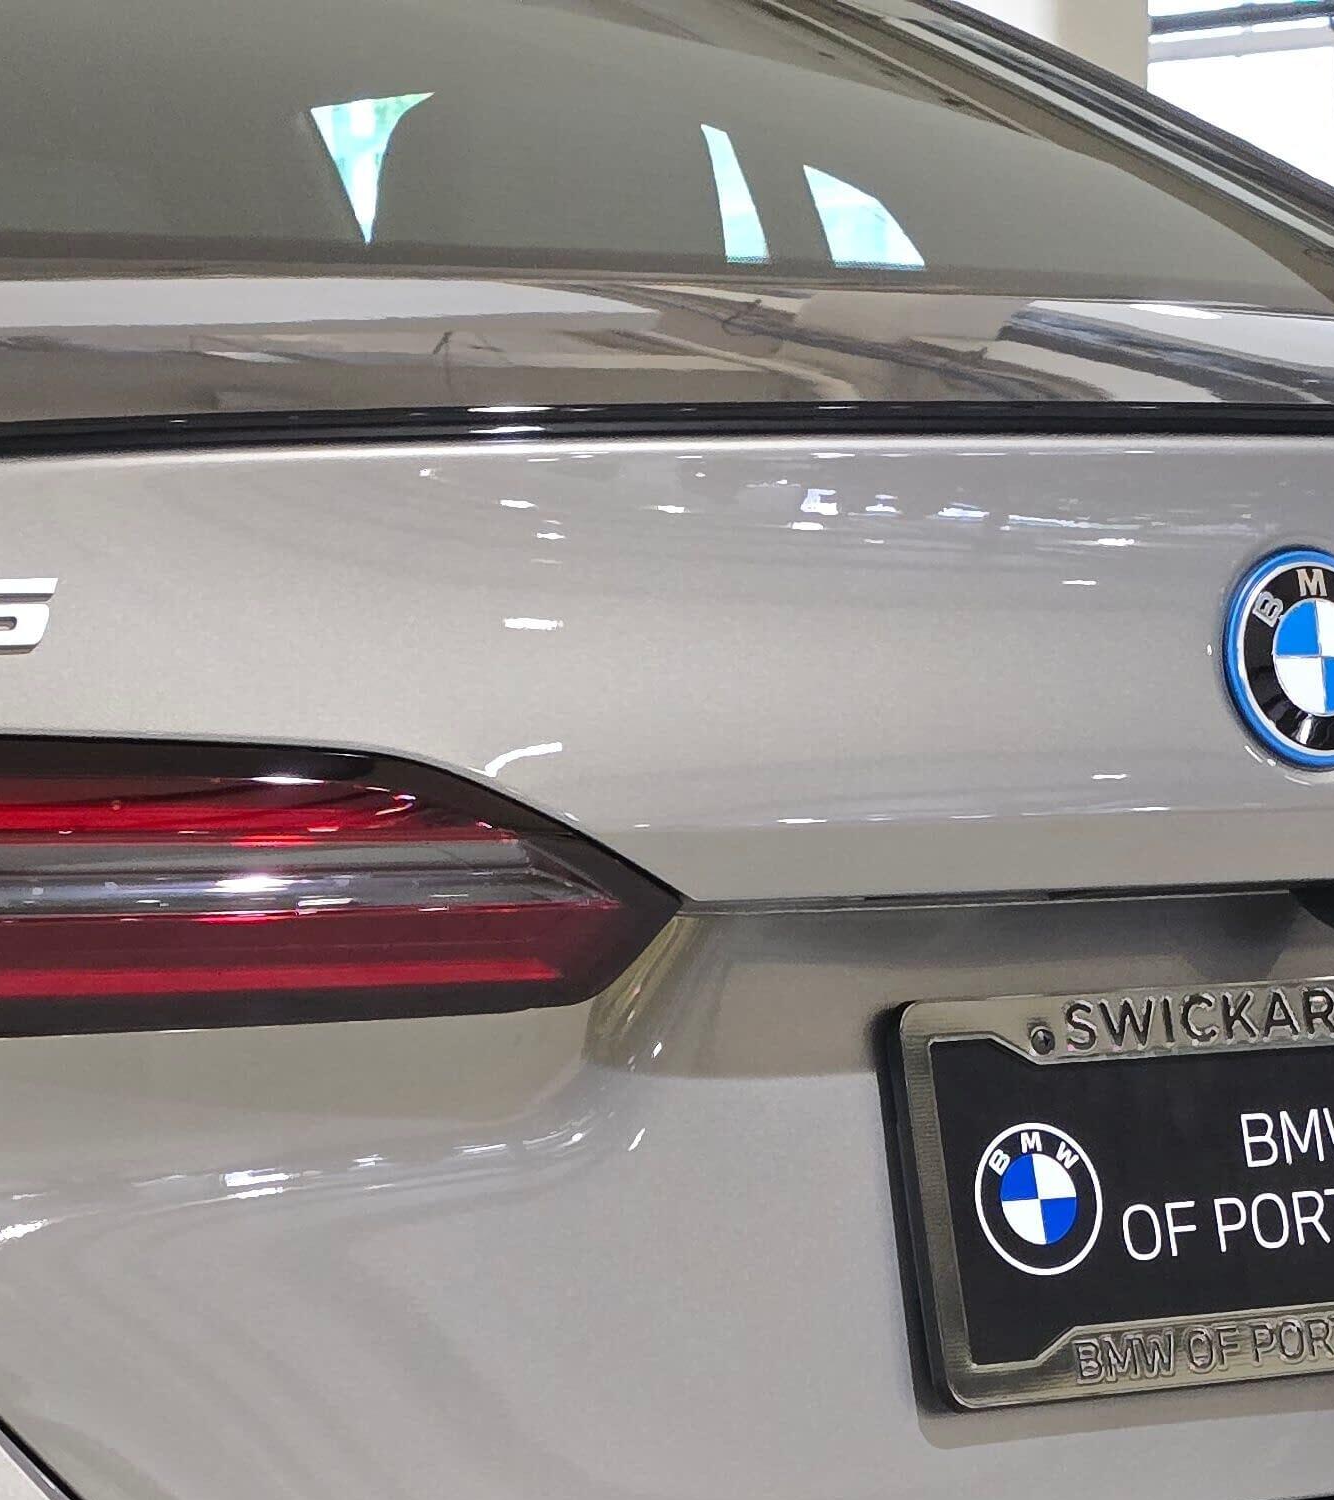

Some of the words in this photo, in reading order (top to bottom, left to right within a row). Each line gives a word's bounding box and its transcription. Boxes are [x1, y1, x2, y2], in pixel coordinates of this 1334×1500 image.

[988, 1131, 1080, 1176] BMW
[1122, 1202, 1197, 1261] OF
[1073, 1330, 1176, 1385] BMW
[1187, 1325, 1238, 1374] OF
